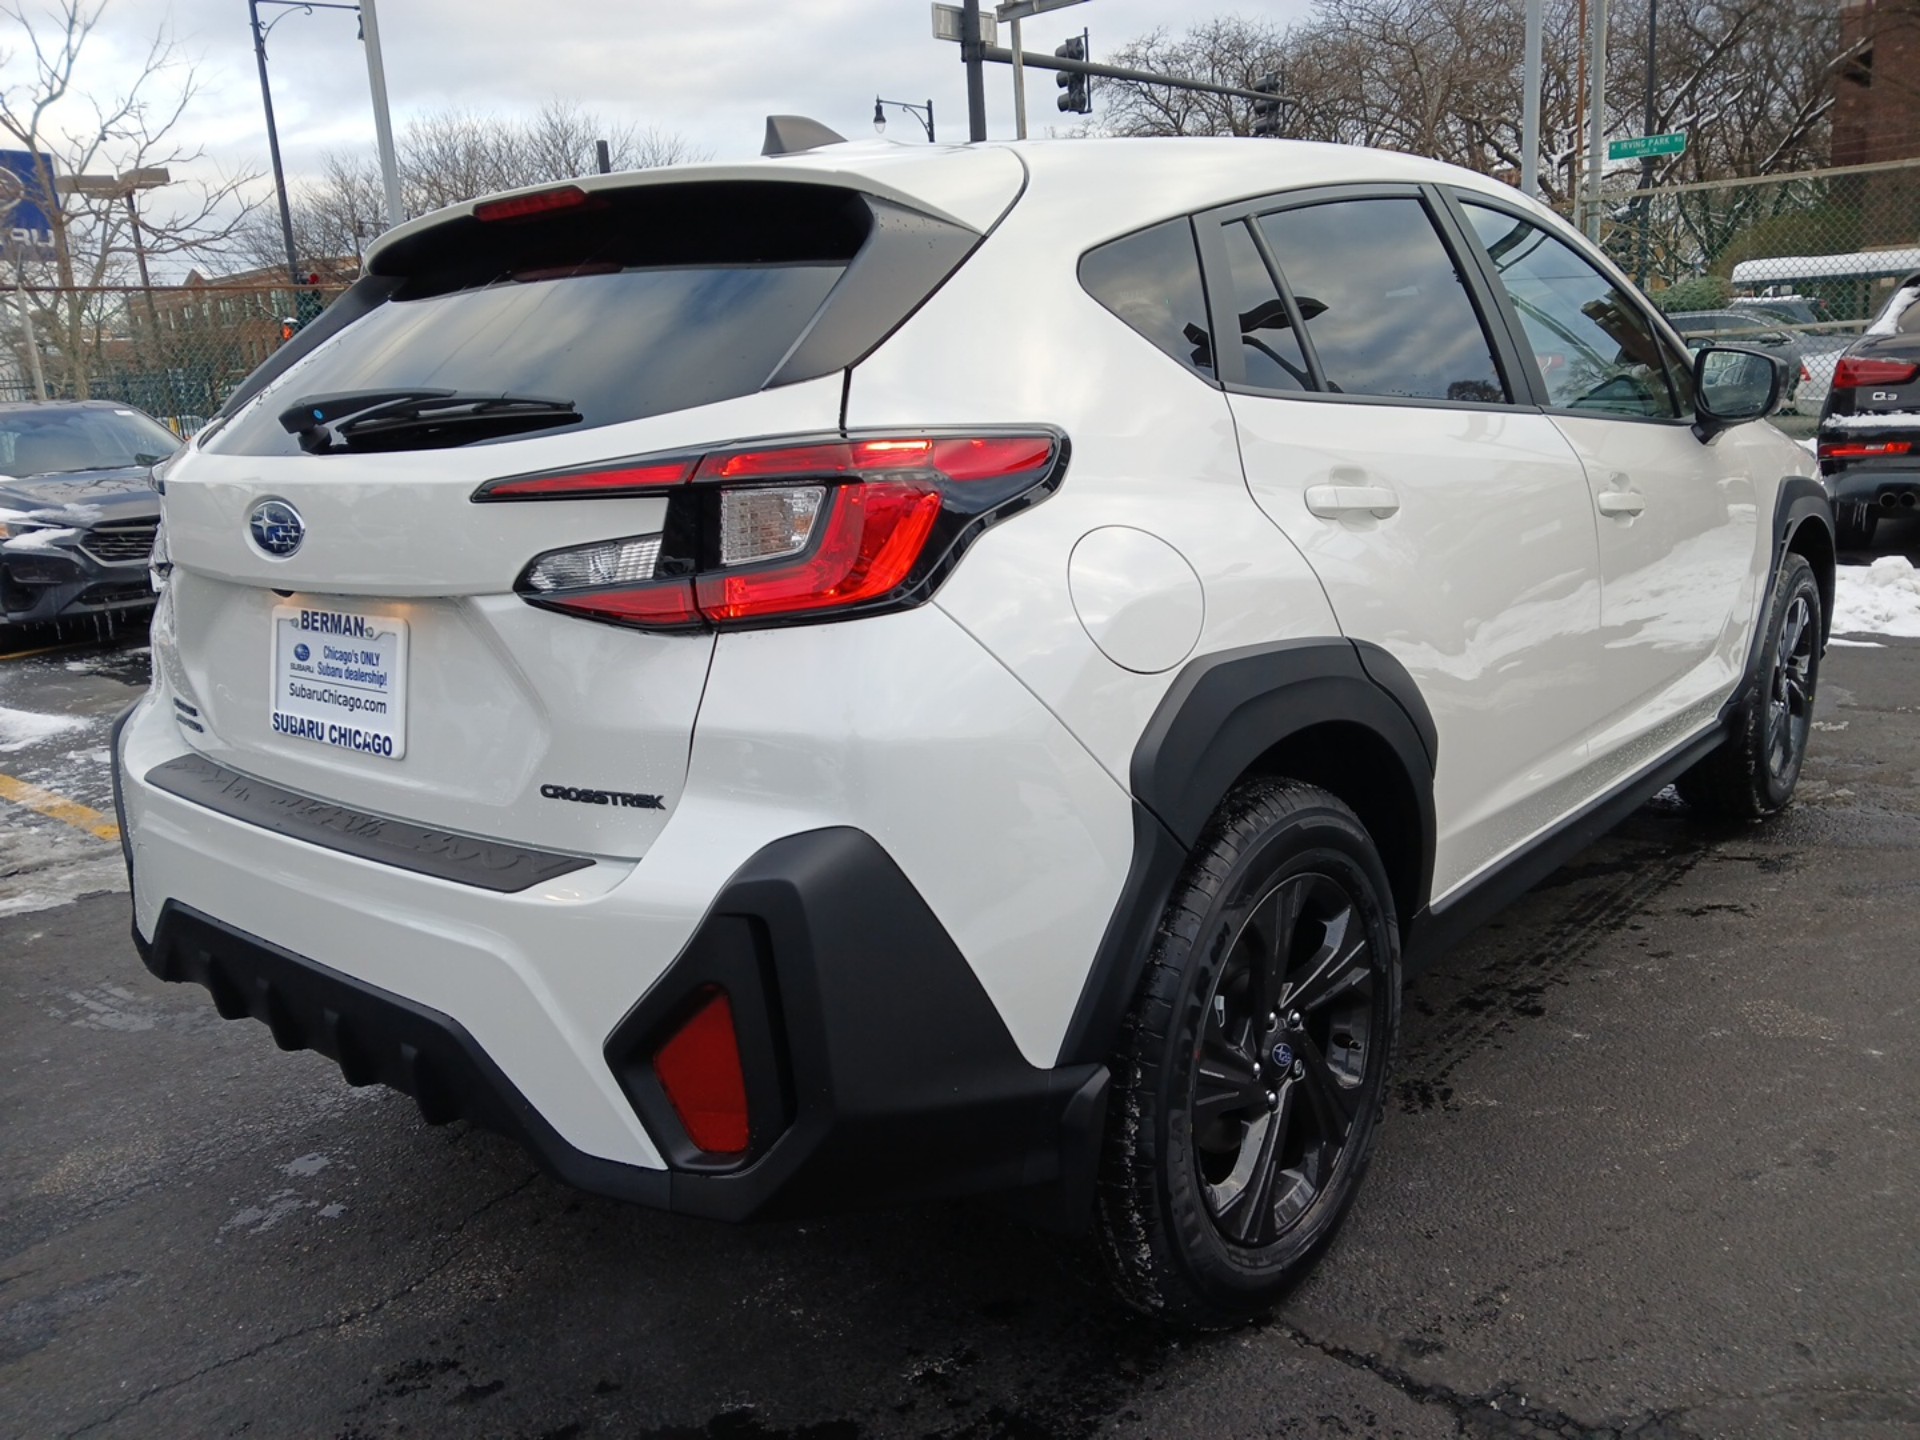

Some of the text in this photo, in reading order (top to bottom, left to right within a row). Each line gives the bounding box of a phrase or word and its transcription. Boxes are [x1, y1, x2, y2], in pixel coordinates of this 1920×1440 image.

[1620, 140, 1646, 150] IRVING
[1648, 137, 1670, 147] PARK
[0, 228, 55, 248] RU
[300, 610, 365, 637] BERMAN
[290, 663, 314, 674] SUBARU
[323, 645, 381, 667] Chicago's ONLY
[317, 662, 387, 688] Subaru dealership!
[289, 682, 387, 714] SubaruChicago.com
[272, 712, 393, 757] SUBARU CHICAGO
[540, 784, 667, 811] CROSSTREK
